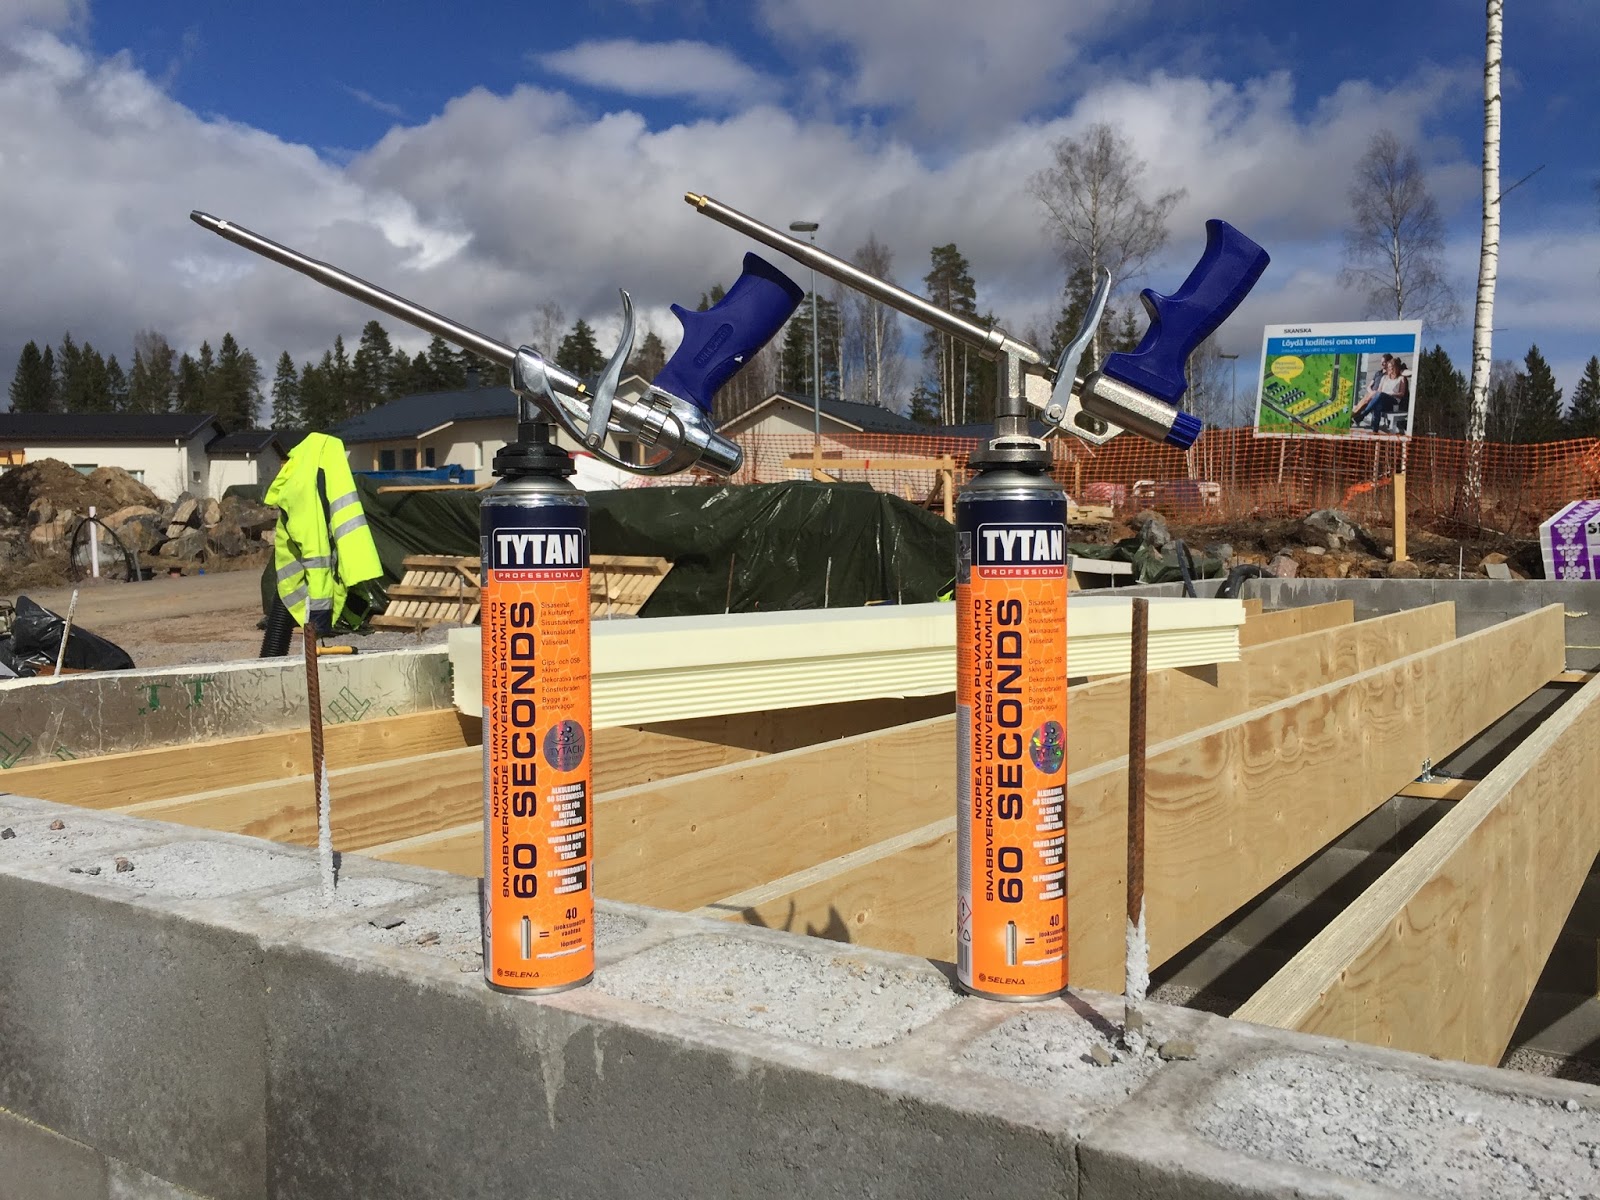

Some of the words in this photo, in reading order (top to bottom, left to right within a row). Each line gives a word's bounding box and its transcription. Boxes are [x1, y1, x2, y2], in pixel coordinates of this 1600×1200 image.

[1281, 339, 1304, 348] Löydä
[1304, 337, 1335, 346] kodillesi
[1354, 337, 1376, 345] tontti
[496, 534, 579, 565] TYTAN
[982, 530, 1063, 562] TYTAN
[983, 568, 1063, 576] PROFESSIONAL
[498, 571, 581, 580] PROFESSIONAL
[974, 599, 982, 688] PU-VAAHTO
[499, 602, 509, 760] UNIVERSIALSKUMLIM
[985, 599, 993, 761] UNIVERSIALSKUMLIM
[510, 601, 537, 818] SECONDS
[974, 691, 982, 763] LIIMAAVA
[997, 599, 1023, 820] SECONDS
[501, 764, 509, 898] SNABBVERKANDE
[985, 765, 994, 902] SNABBVERKANDE
[512, 843, 538, 899] 60
[997, 846, 1023, 904] 60
[565, 906, 578, 920] 40
[1049, 914, 1060, 927] 40
[503, 969, 540, 979] SELENA
[987, 975, 1026, 985] SELENA
